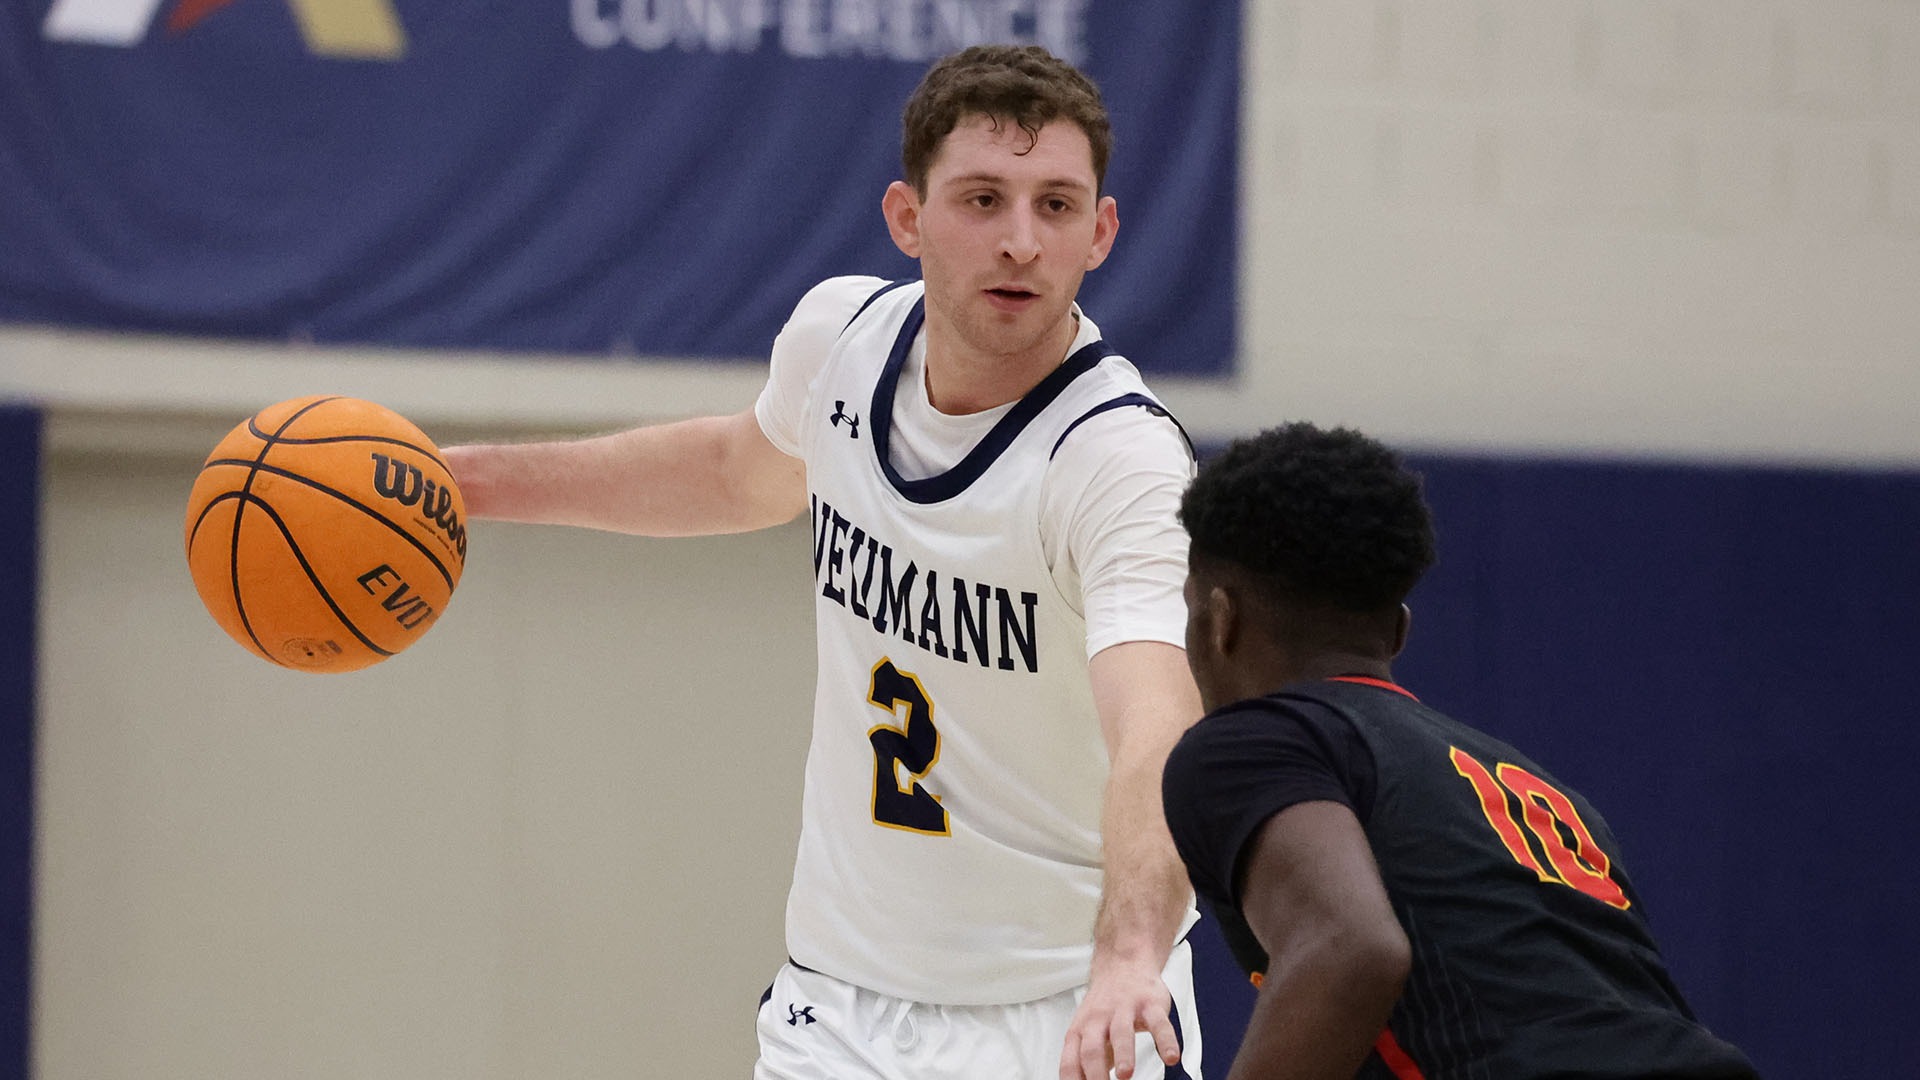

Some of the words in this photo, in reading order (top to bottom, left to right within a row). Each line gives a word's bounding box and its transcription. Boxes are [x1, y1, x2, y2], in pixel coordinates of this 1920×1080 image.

[370, 451, 467, 567] Wilso
[866, 655, 952, 838] 2
[1449, 745, 1632, 911] 10
